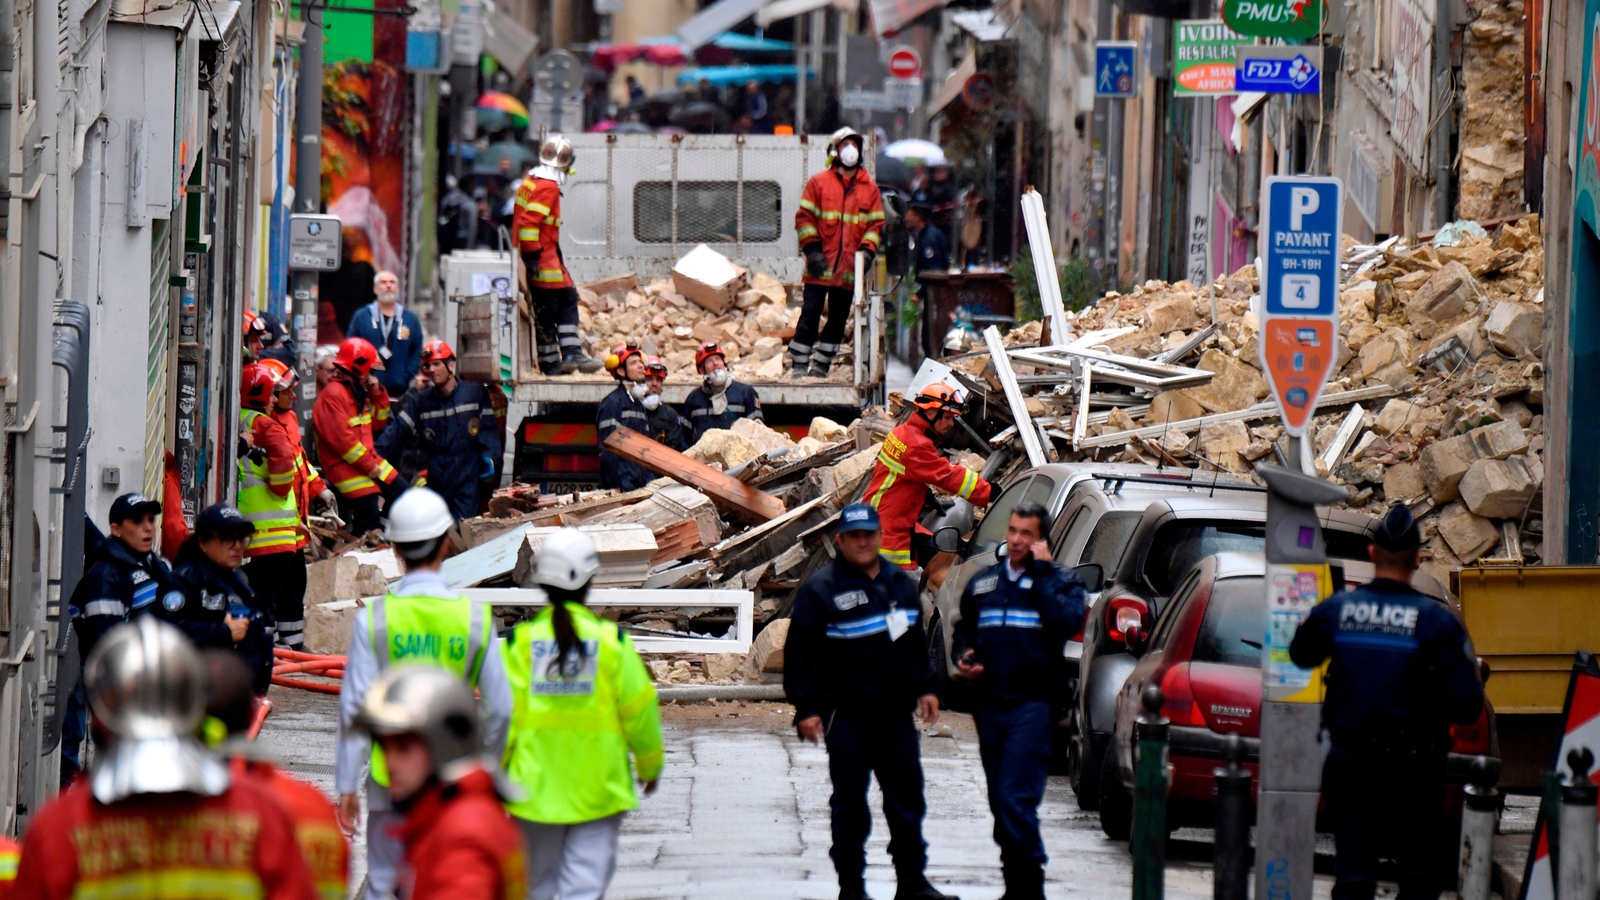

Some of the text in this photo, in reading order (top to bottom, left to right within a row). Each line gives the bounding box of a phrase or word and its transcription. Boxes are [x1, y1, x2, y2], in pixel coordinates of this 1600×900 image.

[1236, 1, 1283, 22] PMU
[1179, 44, 1236, 60] RESTAURA
[1210, 66, 1236, 77] MAM
[1247, 61, 1282, 77] FDJ
[1197, 79, 1235, 90] AFRICA
[1290, 186, 1320, 231] P
[1275, 231, 1331, 247] PAYANT
[1283, 258, 1322, 270] 9H-19H
[1296, 286, 1306, 301] 4
[1340, 602, 1419, 629] POLICE
[393, 634, 465, 661] SAMU 13
[1210, 705, 1252, 718] RENAULT
